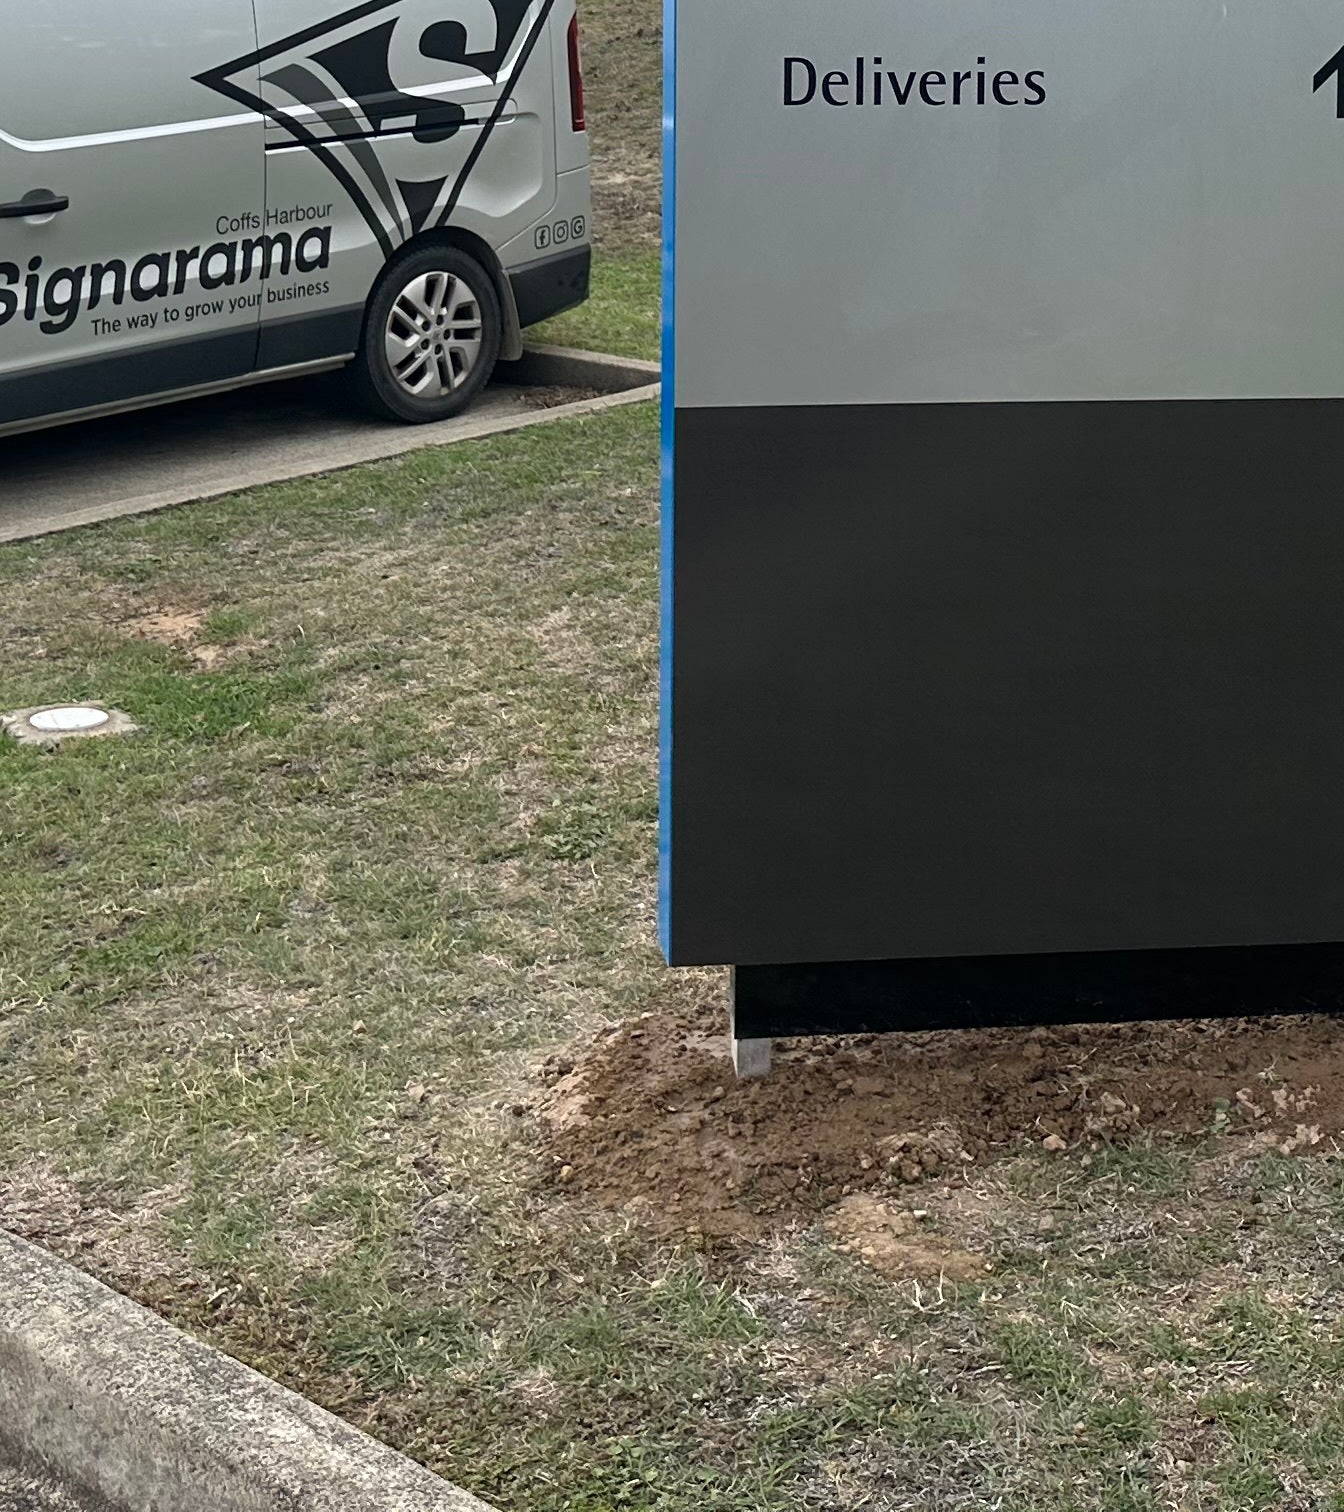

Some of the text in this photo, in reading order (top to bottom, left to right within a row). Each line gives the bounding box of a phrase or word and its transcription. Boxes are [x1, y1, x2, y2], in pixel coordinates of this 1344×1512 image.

[783, 57, 1047, 107] Deliveries
[216, 203, 333, 235] Coffs Harbour
[91, 280, 330, 336] The way to grow your business
